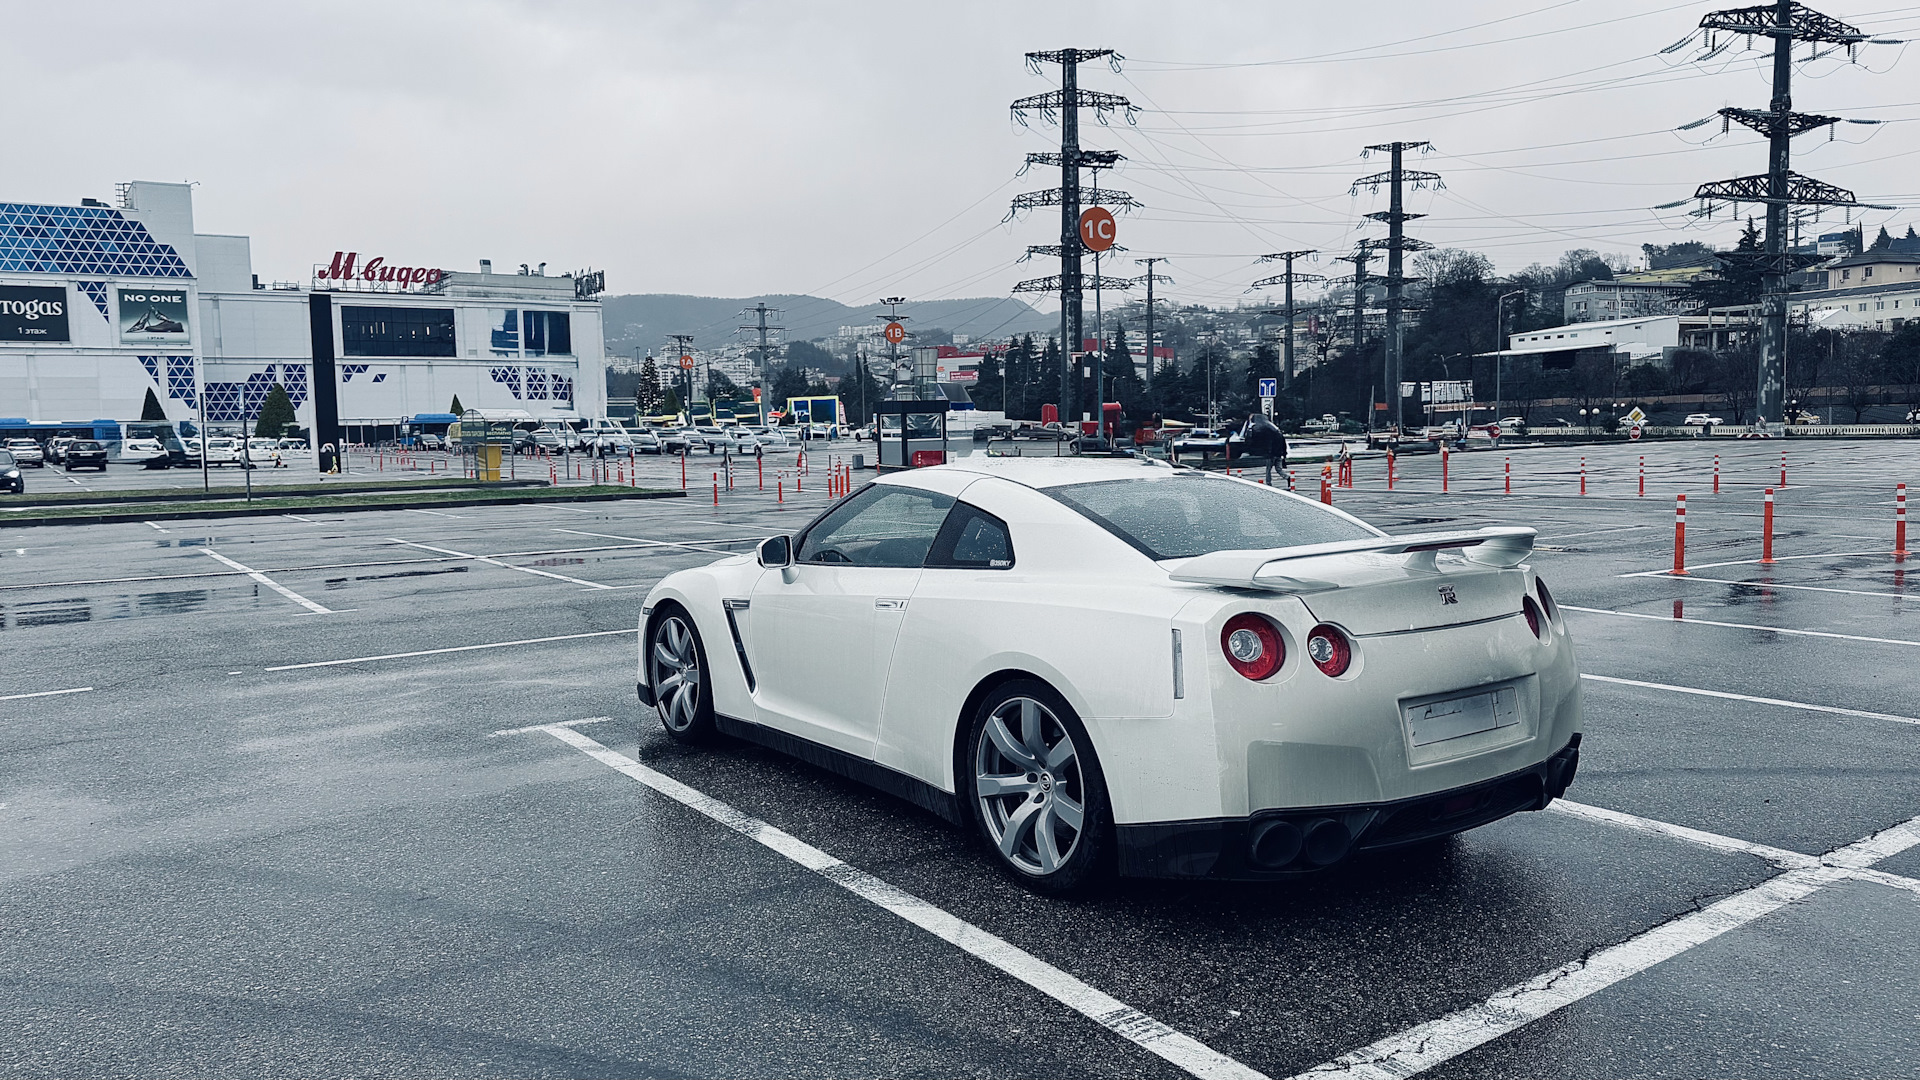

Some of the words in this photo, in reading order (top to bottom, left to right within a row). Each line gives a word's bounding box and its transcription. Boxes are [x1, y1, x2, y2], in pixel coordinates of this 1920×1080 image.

[1084, 219, 1112, 239] 1C
[124, 294, 146, 302] NO
[149, 295, 182, 303] ONE
[888, 328, 902, 338] 1B
